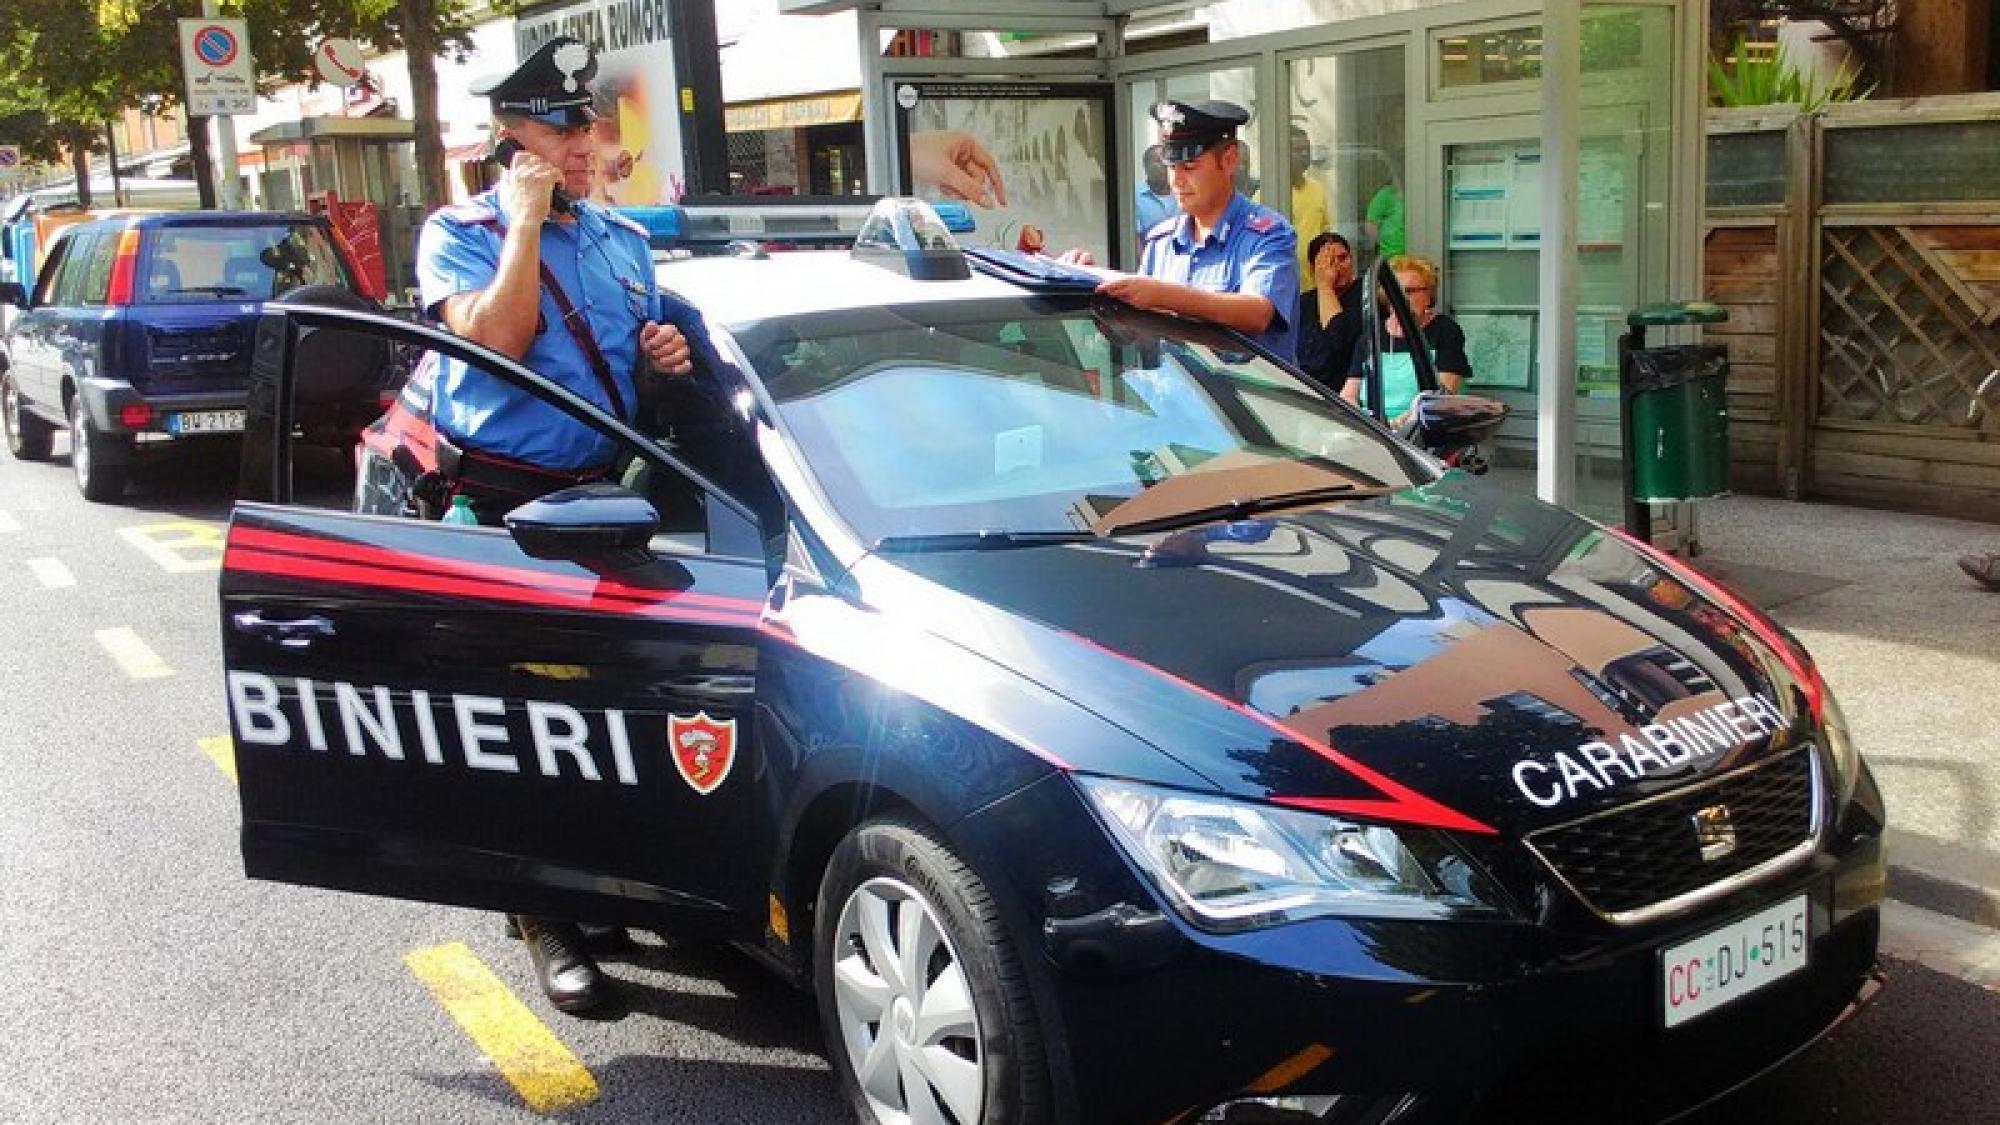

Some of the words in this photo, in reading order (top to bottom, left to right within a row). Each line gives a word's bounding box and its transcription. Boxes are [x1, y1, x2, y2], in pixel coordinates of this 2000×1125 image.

[228, 669, 639, 786] BINIERI
[1511, 691, 1792, 807] CARABINIERI
[1669, 957, 1701, 1008] CC
[1718, 935, 1748, 988] DJ
[1761, 911, 1804, 967] 515
